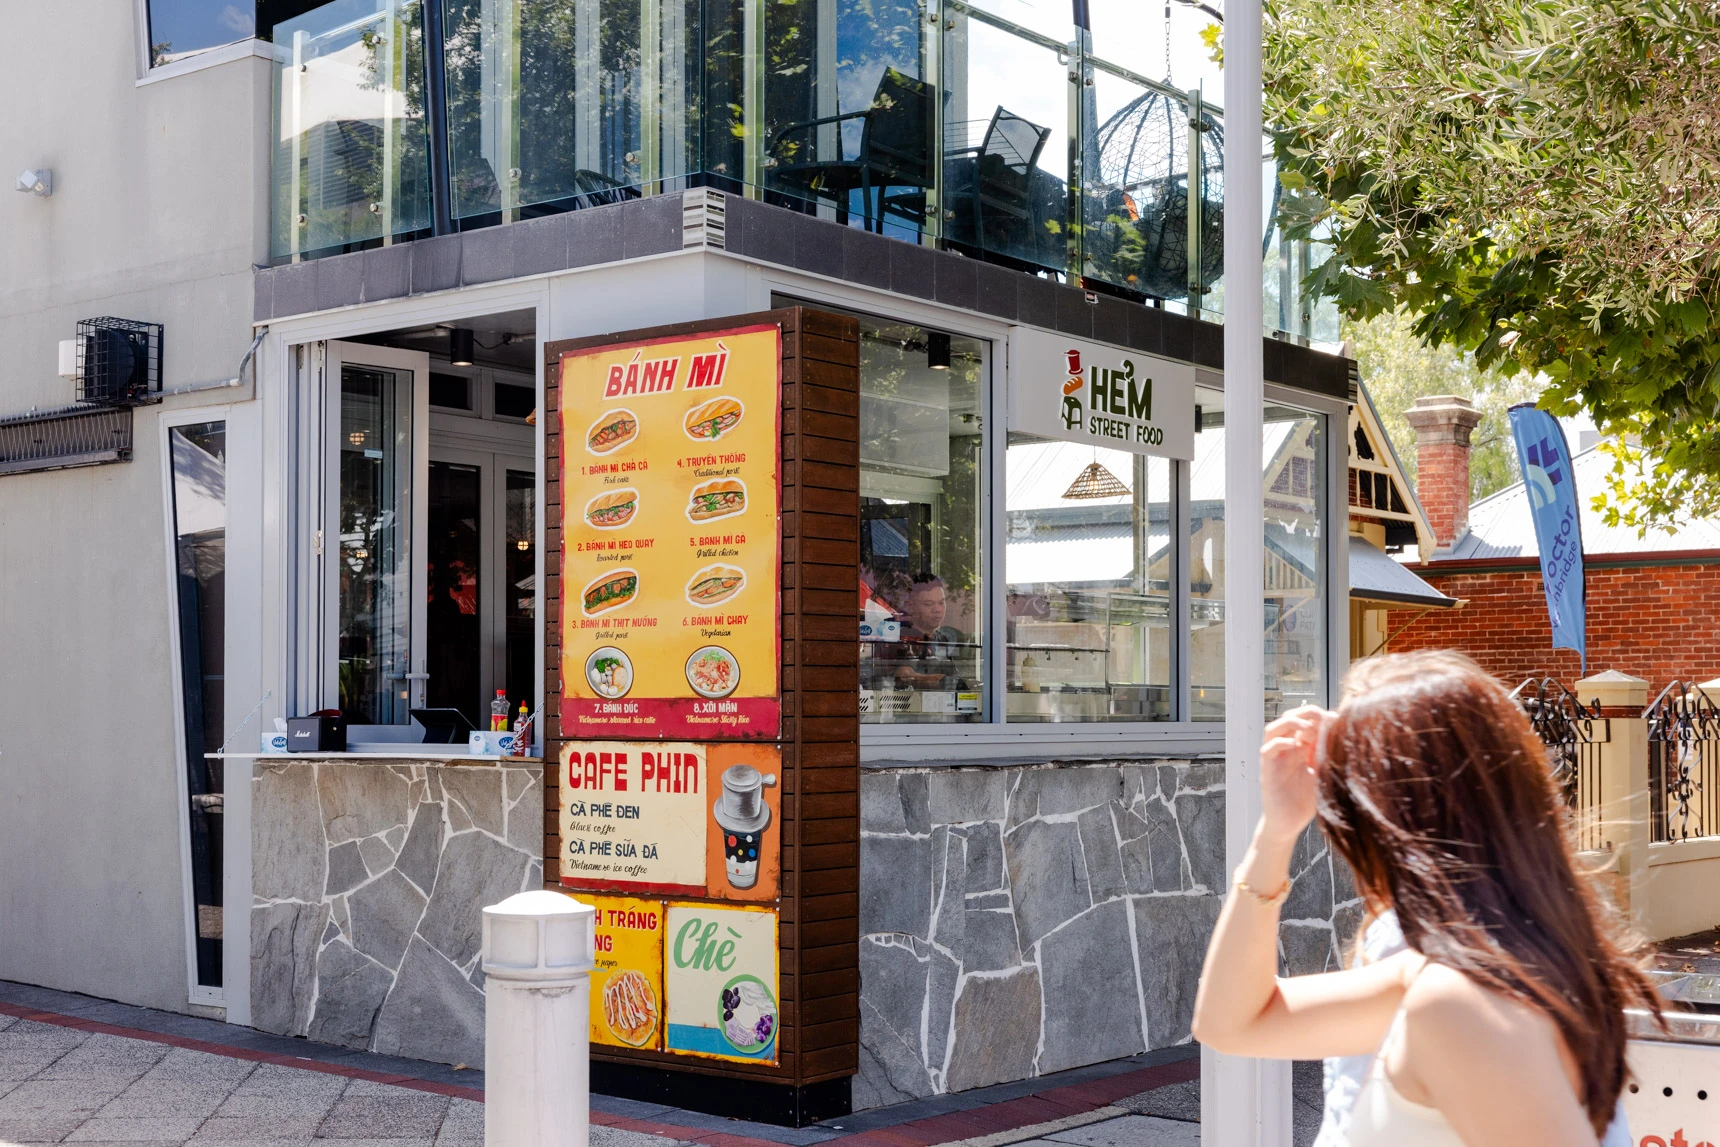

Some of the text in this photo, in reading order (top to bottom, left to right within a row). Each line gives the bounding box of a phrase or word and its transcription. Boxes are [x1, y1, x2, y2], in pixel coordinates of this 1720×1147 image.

[603, 342, 728, 398] BÁNH MÌ
[1090, 416, 1163, 446] STREET FOOD
[581, 466, 587, 475] 1.
[677, 459, 684, 468] 4.
[577, 543, 584, 551] 2.
[619, 540, 633, 549] HEO
[635, 539, 655, 548] QUAY
[690, 537, 697, 546] 5.
[1546, 504, 1574, 594] octor
[571, 620, 578, 629] 3.
[682, 616, 689, 626] 6.
[727, 615, 749, 625] CHAY
[700, 628, 732, 639] Vegetarian
[685, 714, 719, 724] Vietnamese
[568, 751, 628, 791] CAFE
[590, 802, 613, 818] PHÊ
[615, 805, 640, 819] ĐEN
[569, 821, 616, 835] Black coffee
[589, 840, 613, 856] PHÊ
[641, 842, 658, 860] ĐÁ
[568, 858, 647, 877] Vietnamese ice coffee
[607, 905, 658, 931] TRÁNG
[673, 917, 743, 973] Chè
